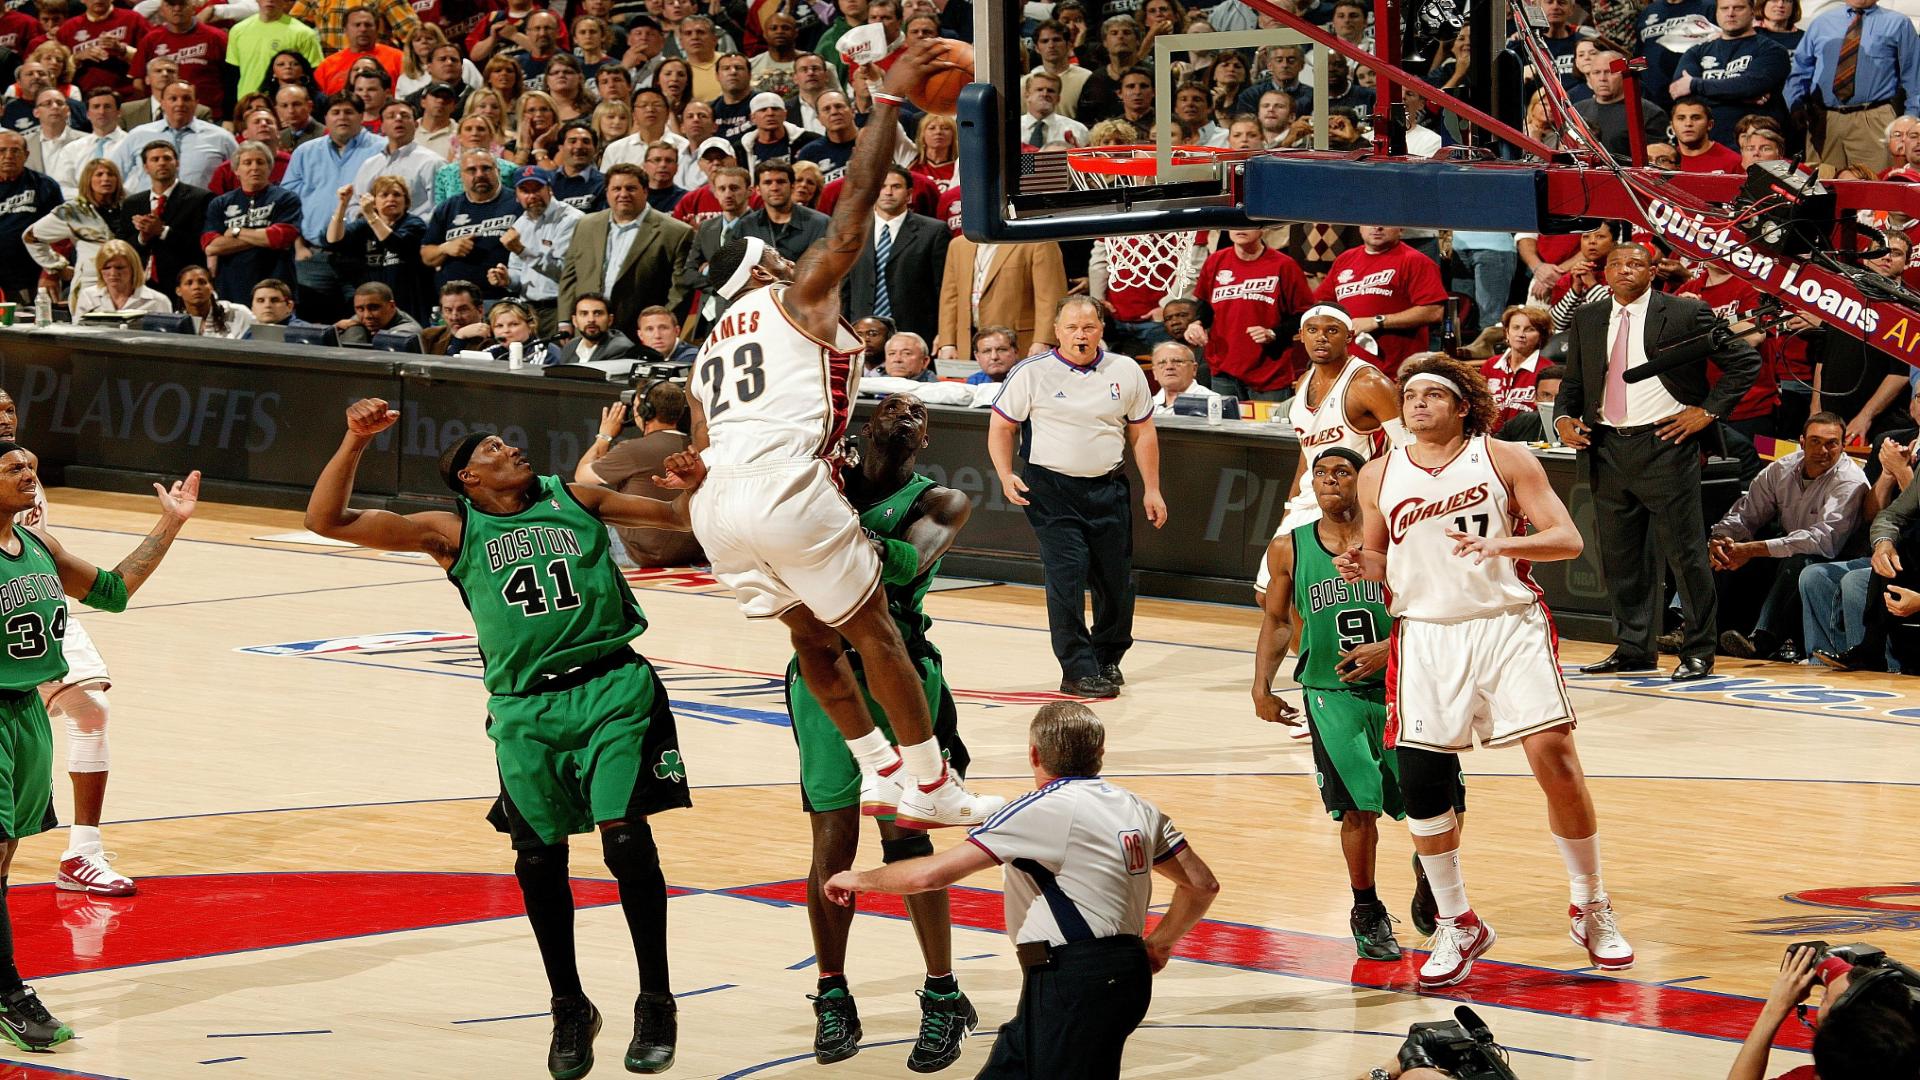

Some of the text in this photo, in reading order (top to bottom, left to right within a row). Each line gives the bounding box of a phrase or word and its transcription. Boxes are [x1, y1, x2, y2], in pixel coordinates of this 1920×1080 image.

[481, 215, 517, 231] UP!
[1211, 276, 1279, 303] RISE UP!
[1335, 269, 1396, 302] RISE UP!
[1648, 199, 1776, 281] Quicken
[1780, 262, 1880, 333] Loans
[700, 342, 766, 421] 23
[17, 363, 281, 453] PLAYOFFS
[1389, 482, 1490, 545] CAVALIERS
[1452, 513, 1490, 539] 17
[485, 525, 583, 574] BOSTON
[501, 558, 582, 617] 41
[5, 604, 68, 660] 34
[1335, 607, 1377, 653] 9
[1123, 833, 1146, 871] 26
